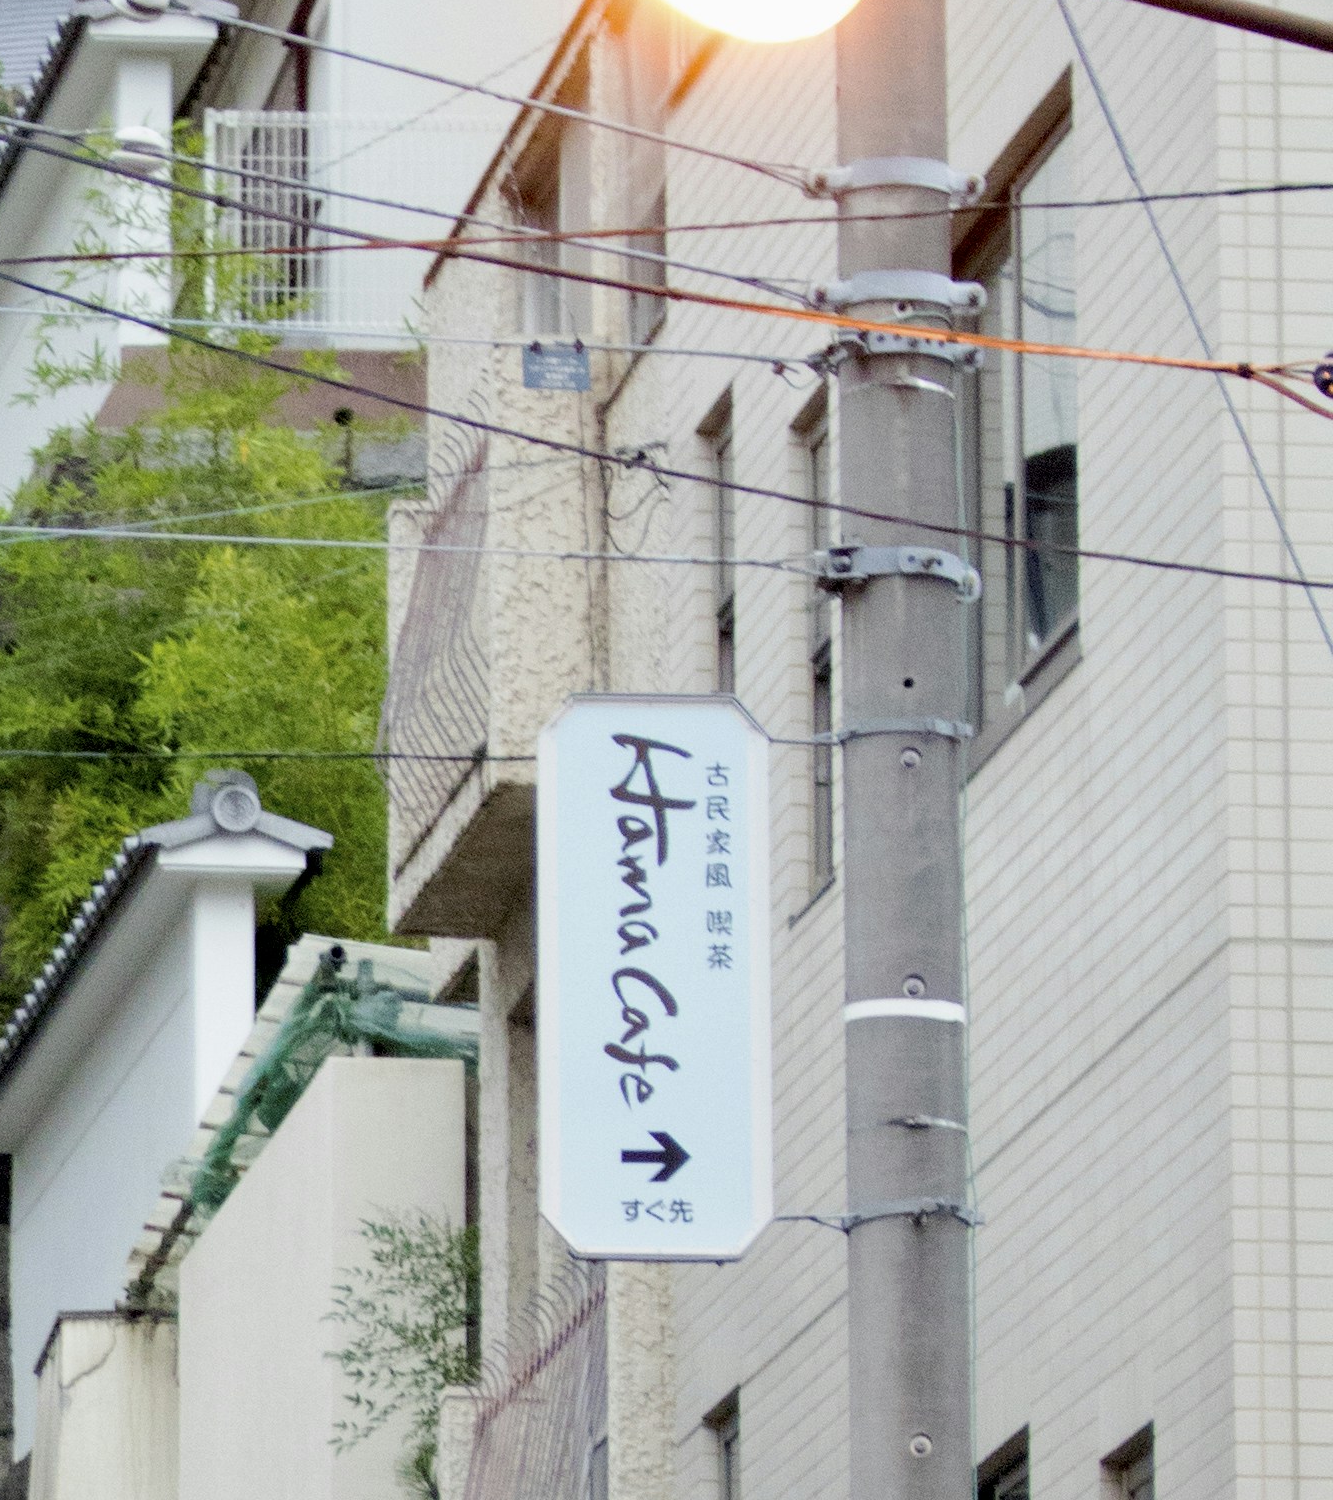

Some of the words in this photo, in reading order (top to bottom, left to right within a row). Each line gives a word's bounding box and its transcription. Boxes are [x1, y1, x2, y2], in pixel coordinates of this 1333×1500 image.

[609, 733, 696, 956] Hama
[706, 762, 733, 889] 古民家風
[706, 910, 733, 970] 喫茶
[604, 967, 680, 1111] Cafe
[621, 1198, 694, 1224] すぐ先
